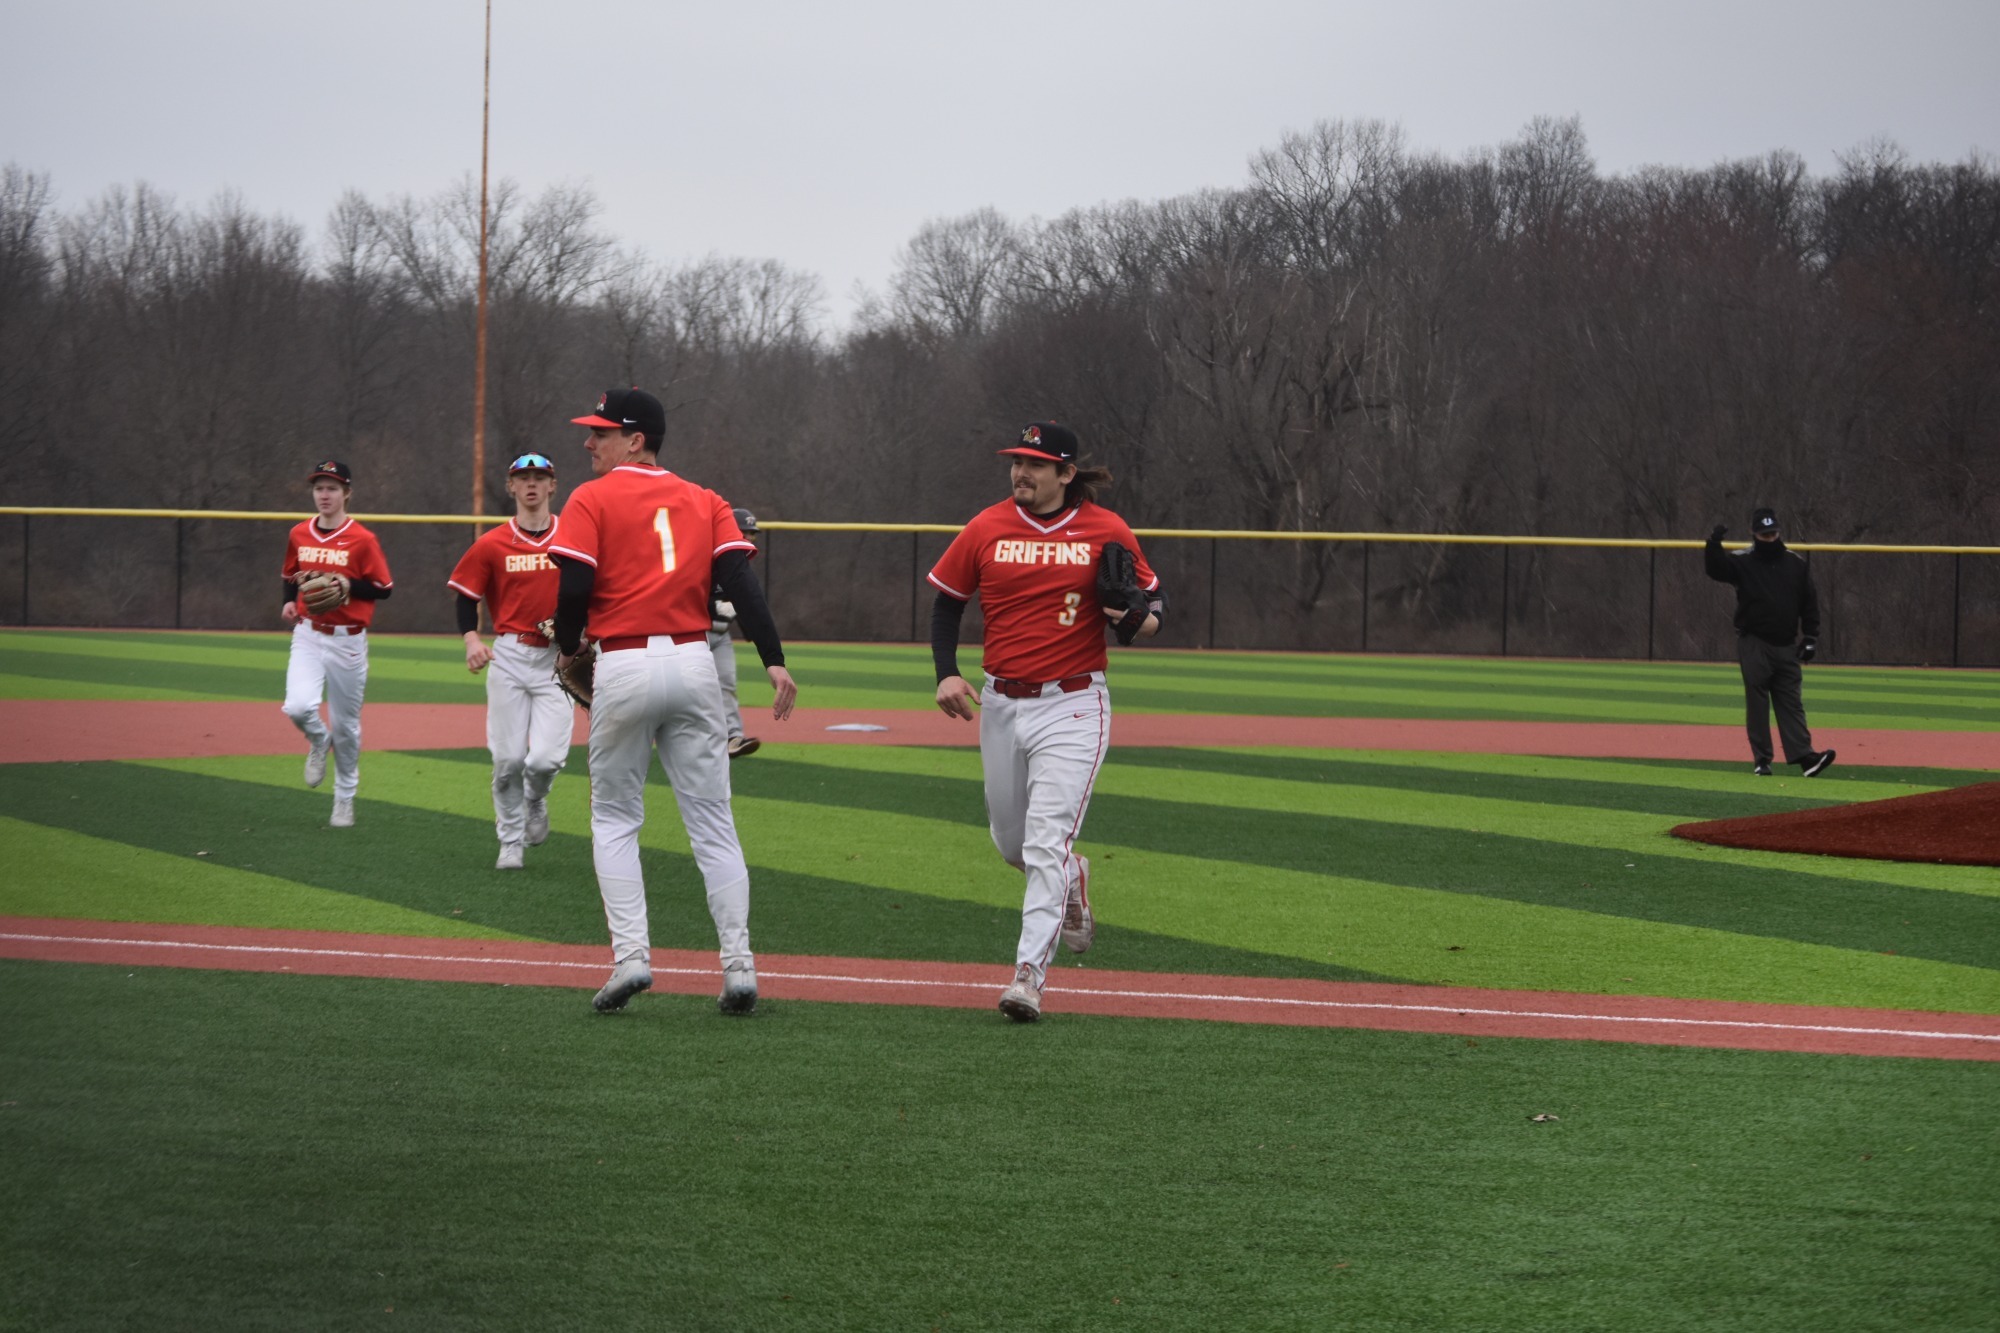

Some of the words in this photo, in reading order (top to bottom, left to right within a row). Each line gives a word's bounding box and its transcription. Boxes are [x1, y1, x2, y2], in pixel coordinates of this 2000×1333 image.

[653, 507, 676, 573] 1
[993, 540, 1091, 566] GRIFFINS
[298, 546, 349, 567] GRIFFINS
[1058, 592, 1081, 627] 3
